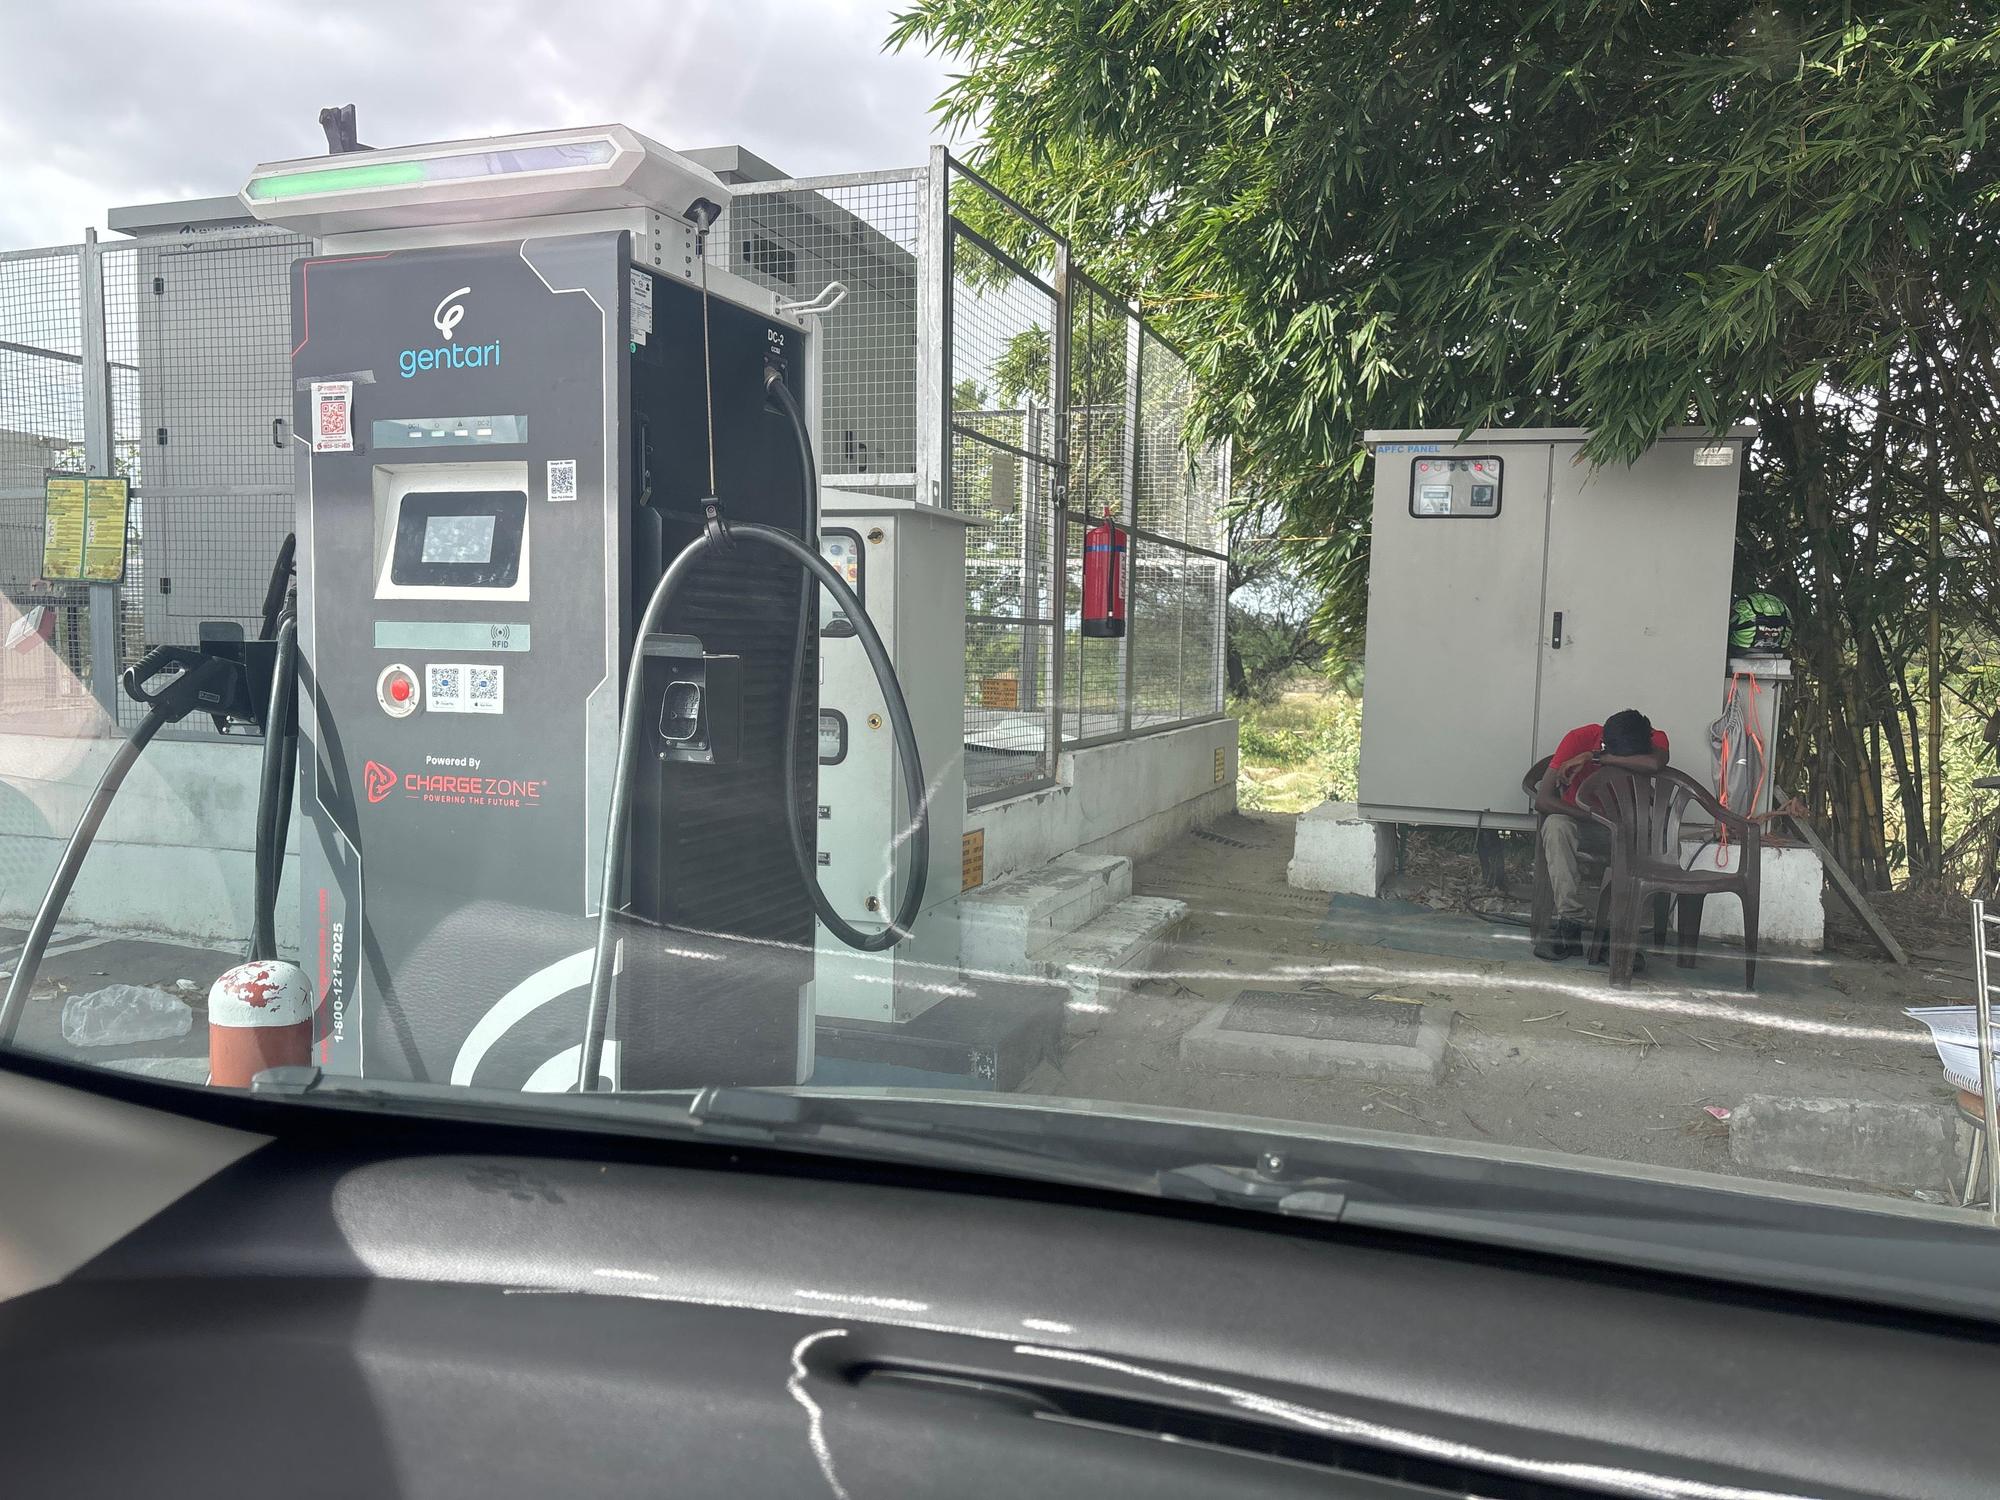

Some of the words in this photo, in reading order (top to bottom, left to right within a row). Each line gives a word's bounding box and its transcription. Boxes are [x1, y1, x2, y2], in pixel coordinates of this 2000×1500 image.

[767, 328, 784, 346] DC-2
[399, 339, 500, 378] gentari
[1378, 445, 1404, 453] APFC
[1407, 445, 1440, 453] PANEL
[491, 640, 509, 648] RFID
[425, 755, 467, 767] Powered
[468, 757, 481, 770] By
[423, 794, 466, 804] POWERING
[469, 796, 485, 805] THE
[486, 798, 520, 807] FUTURE
[333, 922, 343, 1042] 1-800-121-2025
